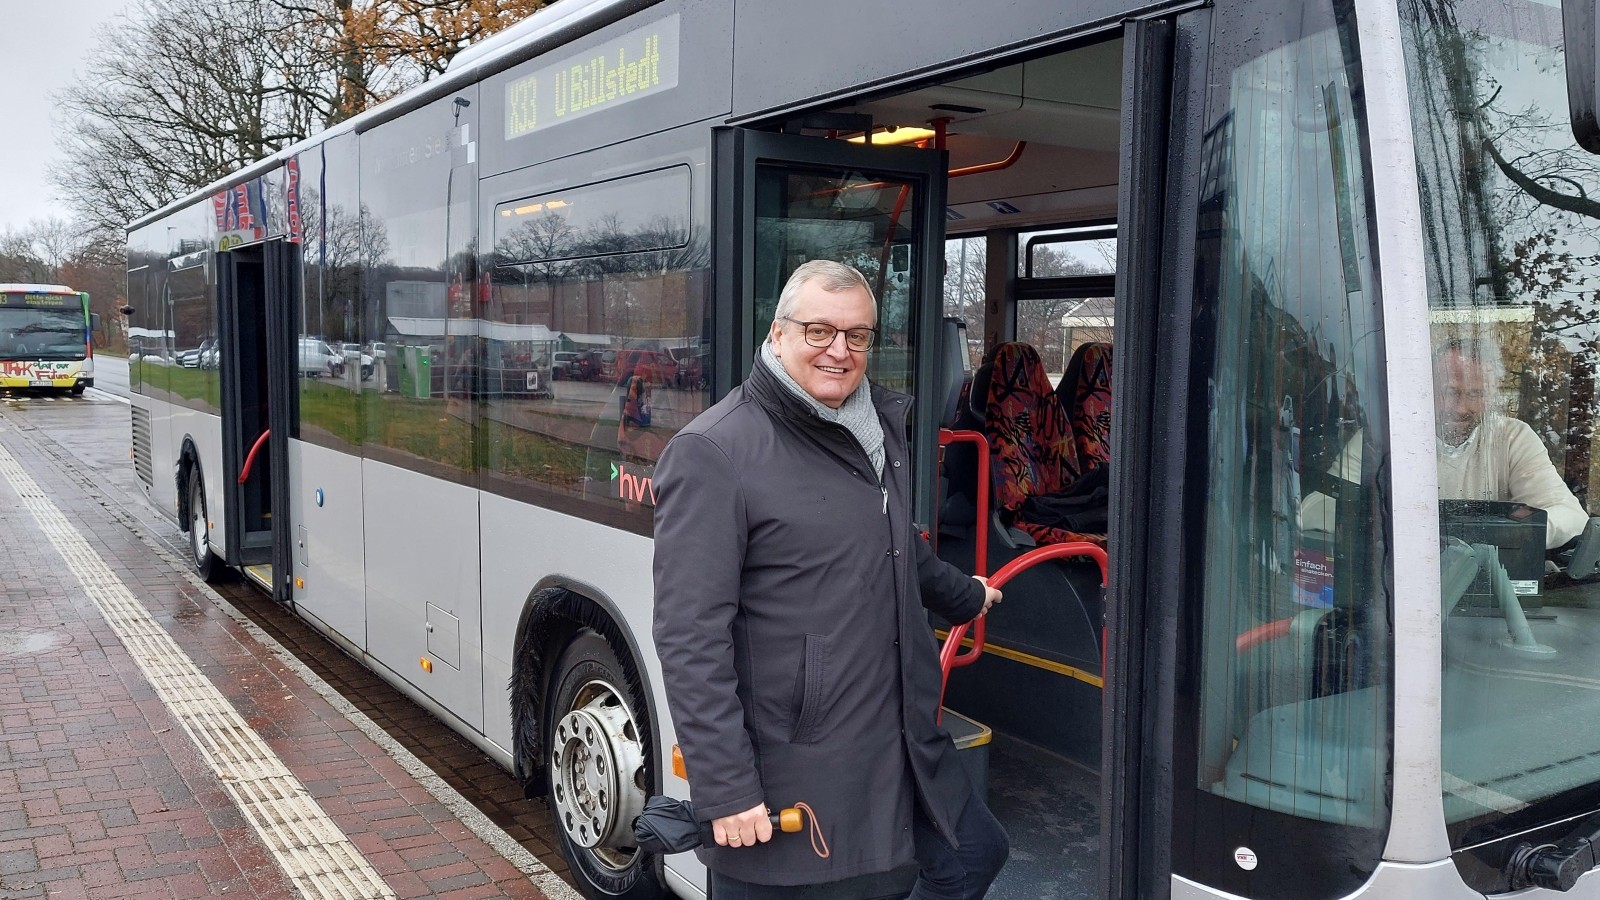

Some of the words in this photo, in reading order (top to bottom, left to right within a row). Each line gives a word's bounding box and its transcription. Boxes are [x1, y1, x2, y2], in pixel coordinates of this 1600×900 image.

[510, 76, 537, 135] X33
[554, 70, 567, 117] U
[570, 34, 660, 112] Billstedt
[1295, 559, 1327, 571] Einfach
